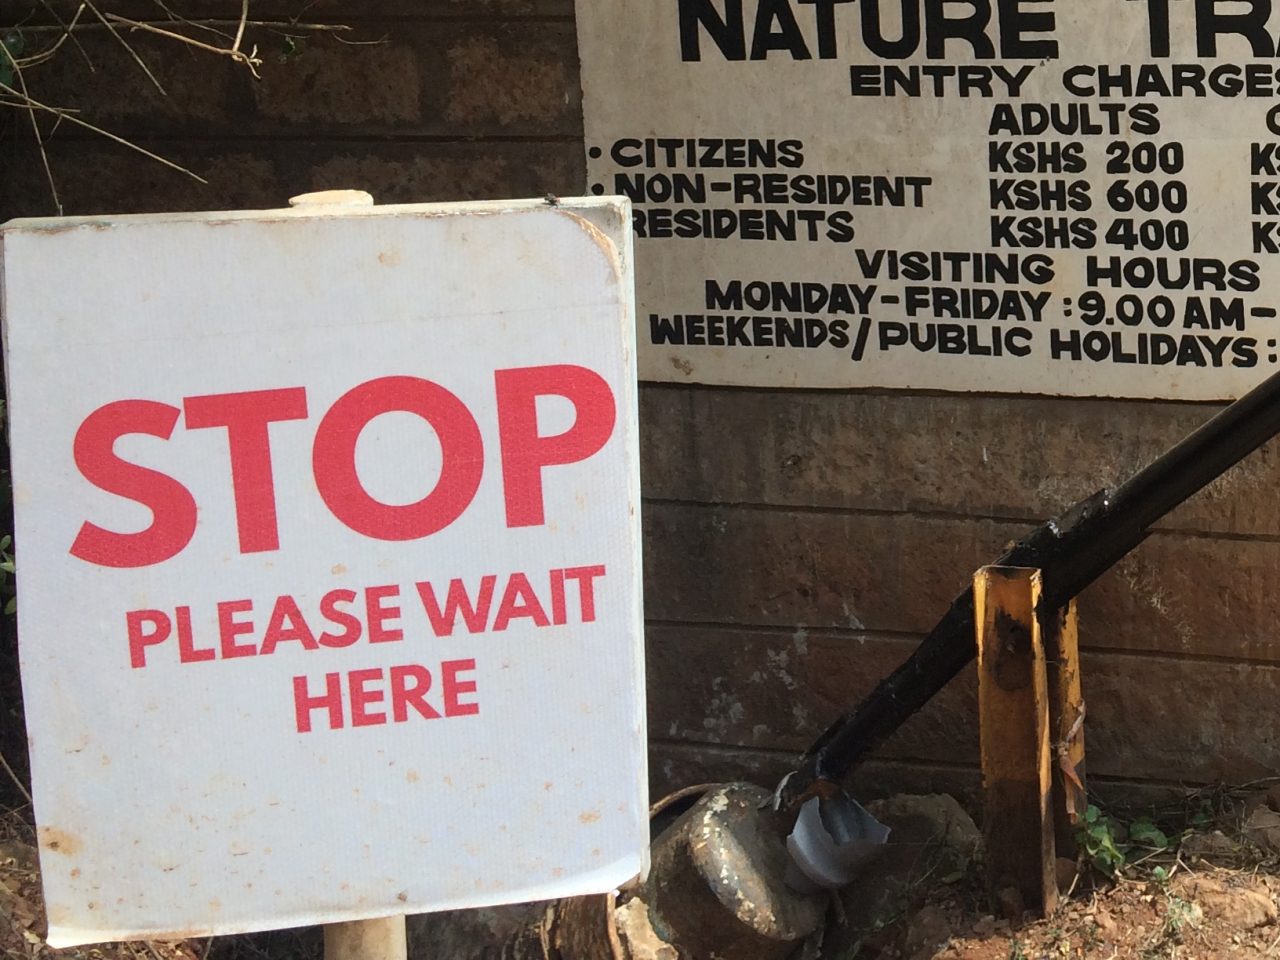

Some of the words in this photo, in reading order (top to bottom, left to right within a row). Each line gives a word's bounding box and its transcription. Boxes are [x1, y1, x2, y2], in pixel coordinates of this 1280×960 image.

[850, 64, 1035, 97] ENTRY
[988, 102, 1161, 136] ADULTS
[610, 139, 804, 168] CITIZENS
[988, 141, 1087, 174] KSHS
[1106, 140, 1184, 175] 200
[614, 173, 932, 208] NON-RESIDENT
[989, 178, 1093, 212] KSHS
[1106, 179, 1188, 213] 600
[990, 215, 1098, 249] KSHS
[1104, 218, 1189, 251] 400
[855, 249, 1056, 285] VISITING
[1086, 255, 1261, 292] HOURS
[69, 364, 617, 569] STOP
[126, 585, 404, 669] PLEASE
[416, 564, 606, 637] WAIT
[293, 658, 480, 733] HERE
